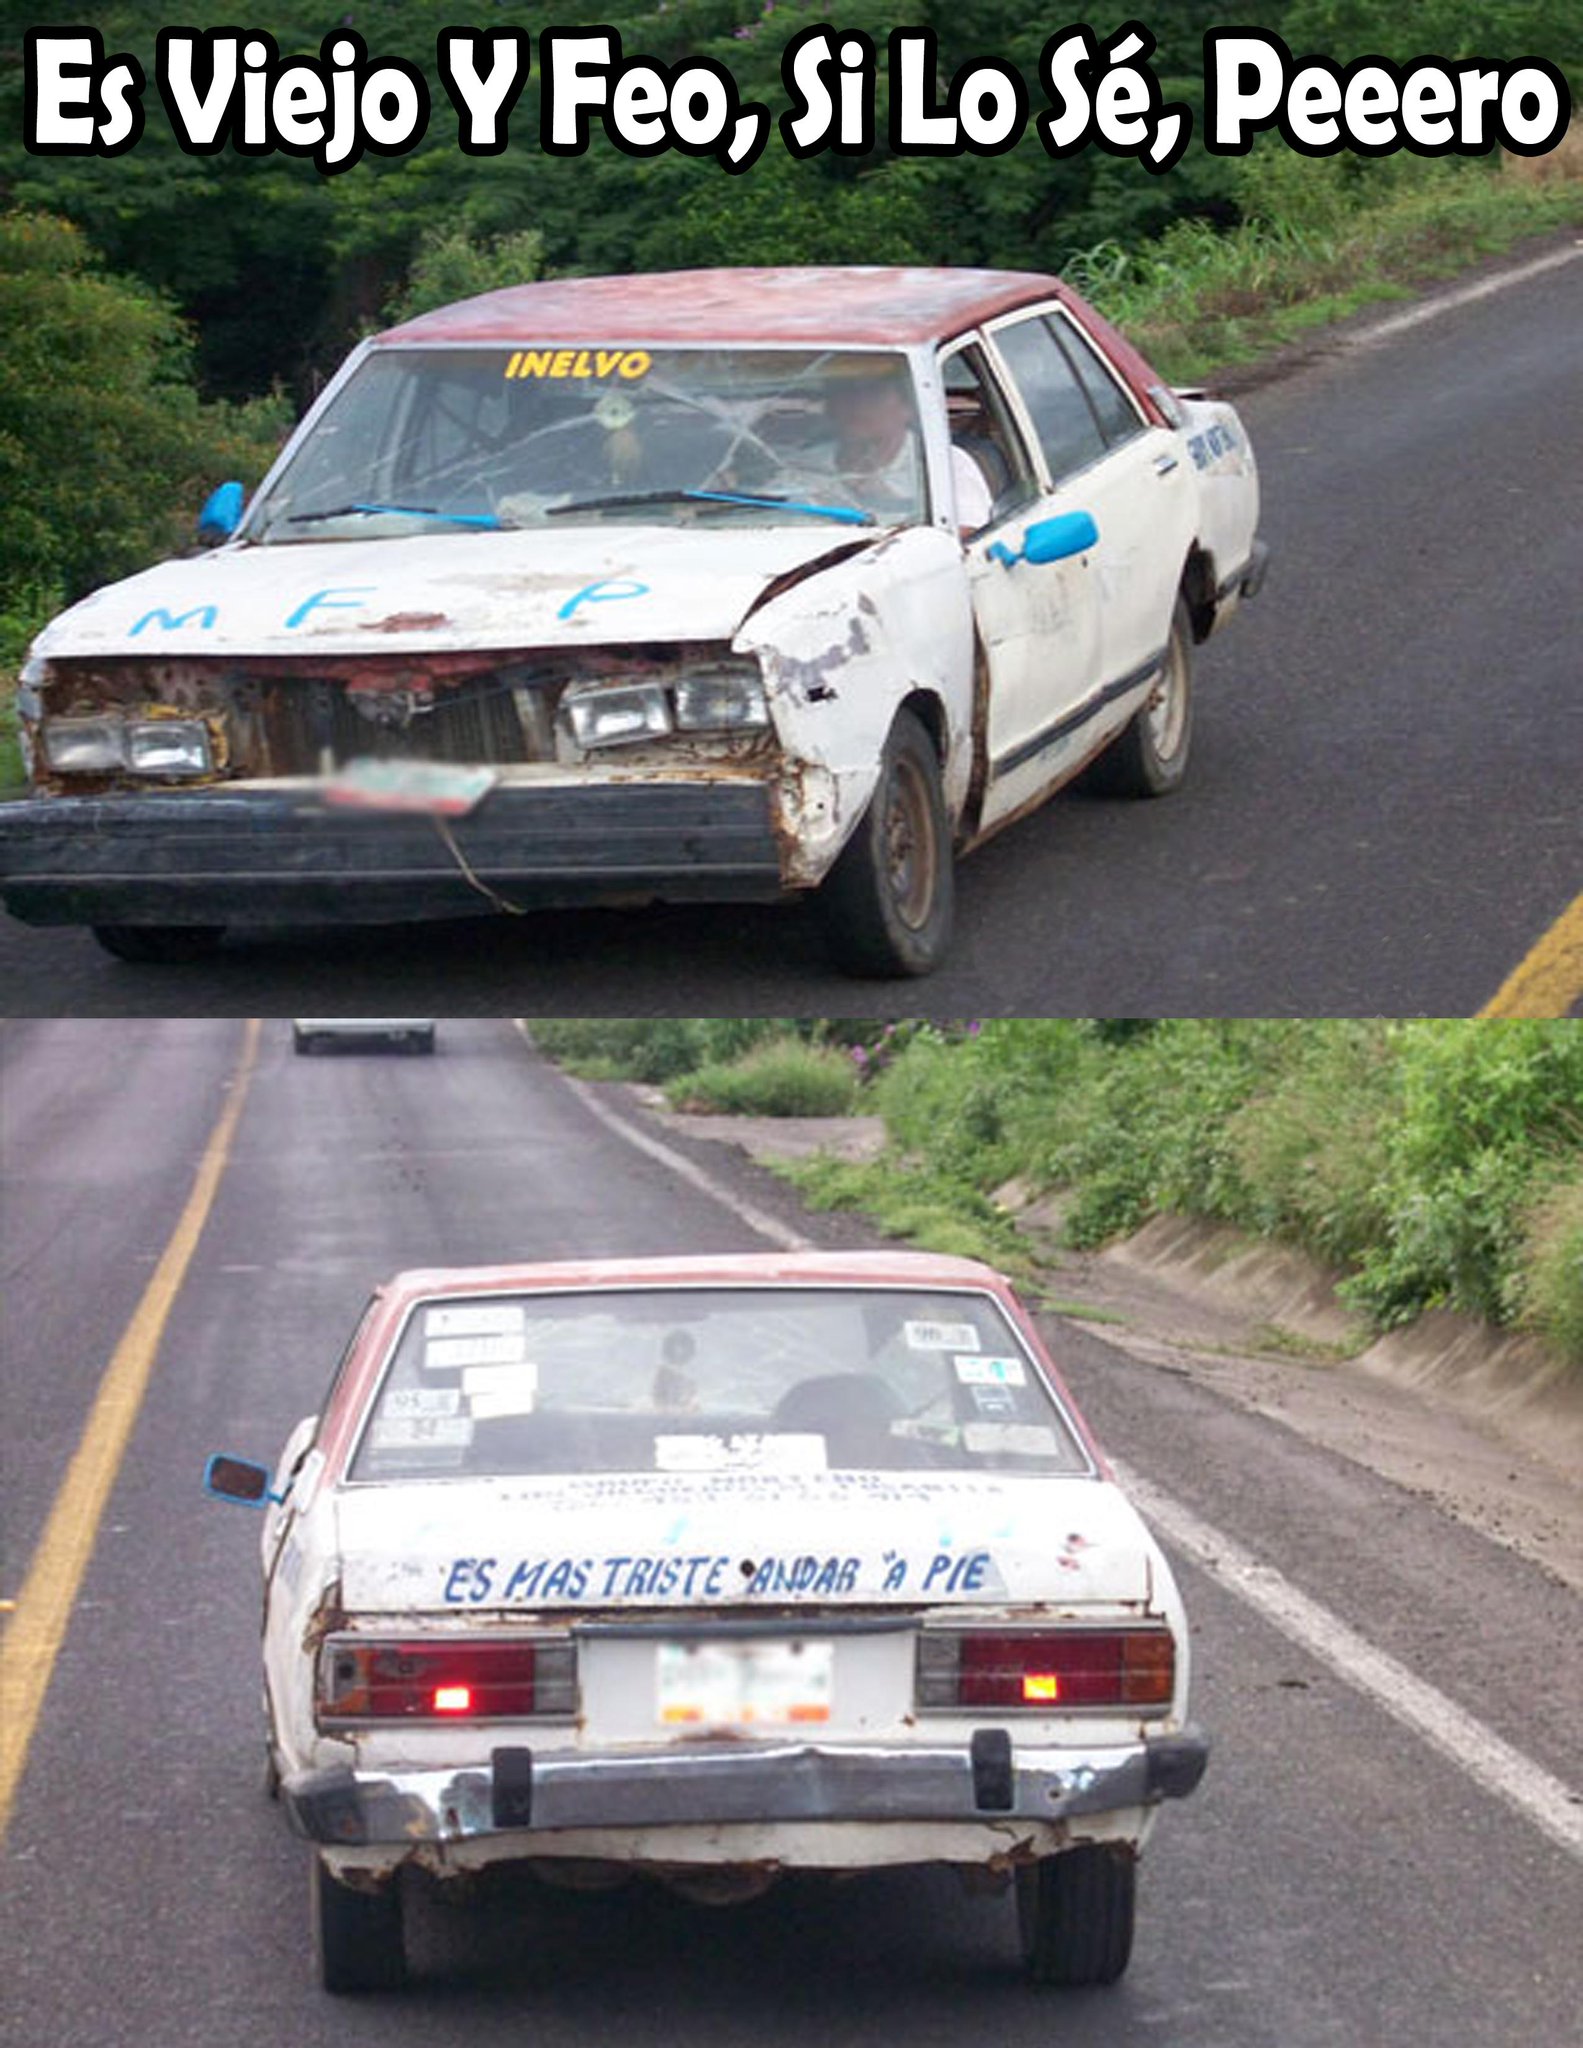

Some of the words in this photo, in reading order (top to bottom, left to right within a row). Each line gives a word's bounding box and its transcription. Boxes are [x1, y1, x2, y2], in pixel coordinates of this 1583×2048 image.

[504, 350, 652, 380] INELVO
[128, 606, 218, 637] M
[284, 585, 379, 629] F
[556, 580, 650, 621] P
[444, 1557, 497, 1602] ES
[503, 1558, 593, 1599] MAS
[603, 1556, 729, 1597] TRISTE
[747, 1556, 861, 1594] ANDAR
[922, 1553, 991, 1592] PIE
